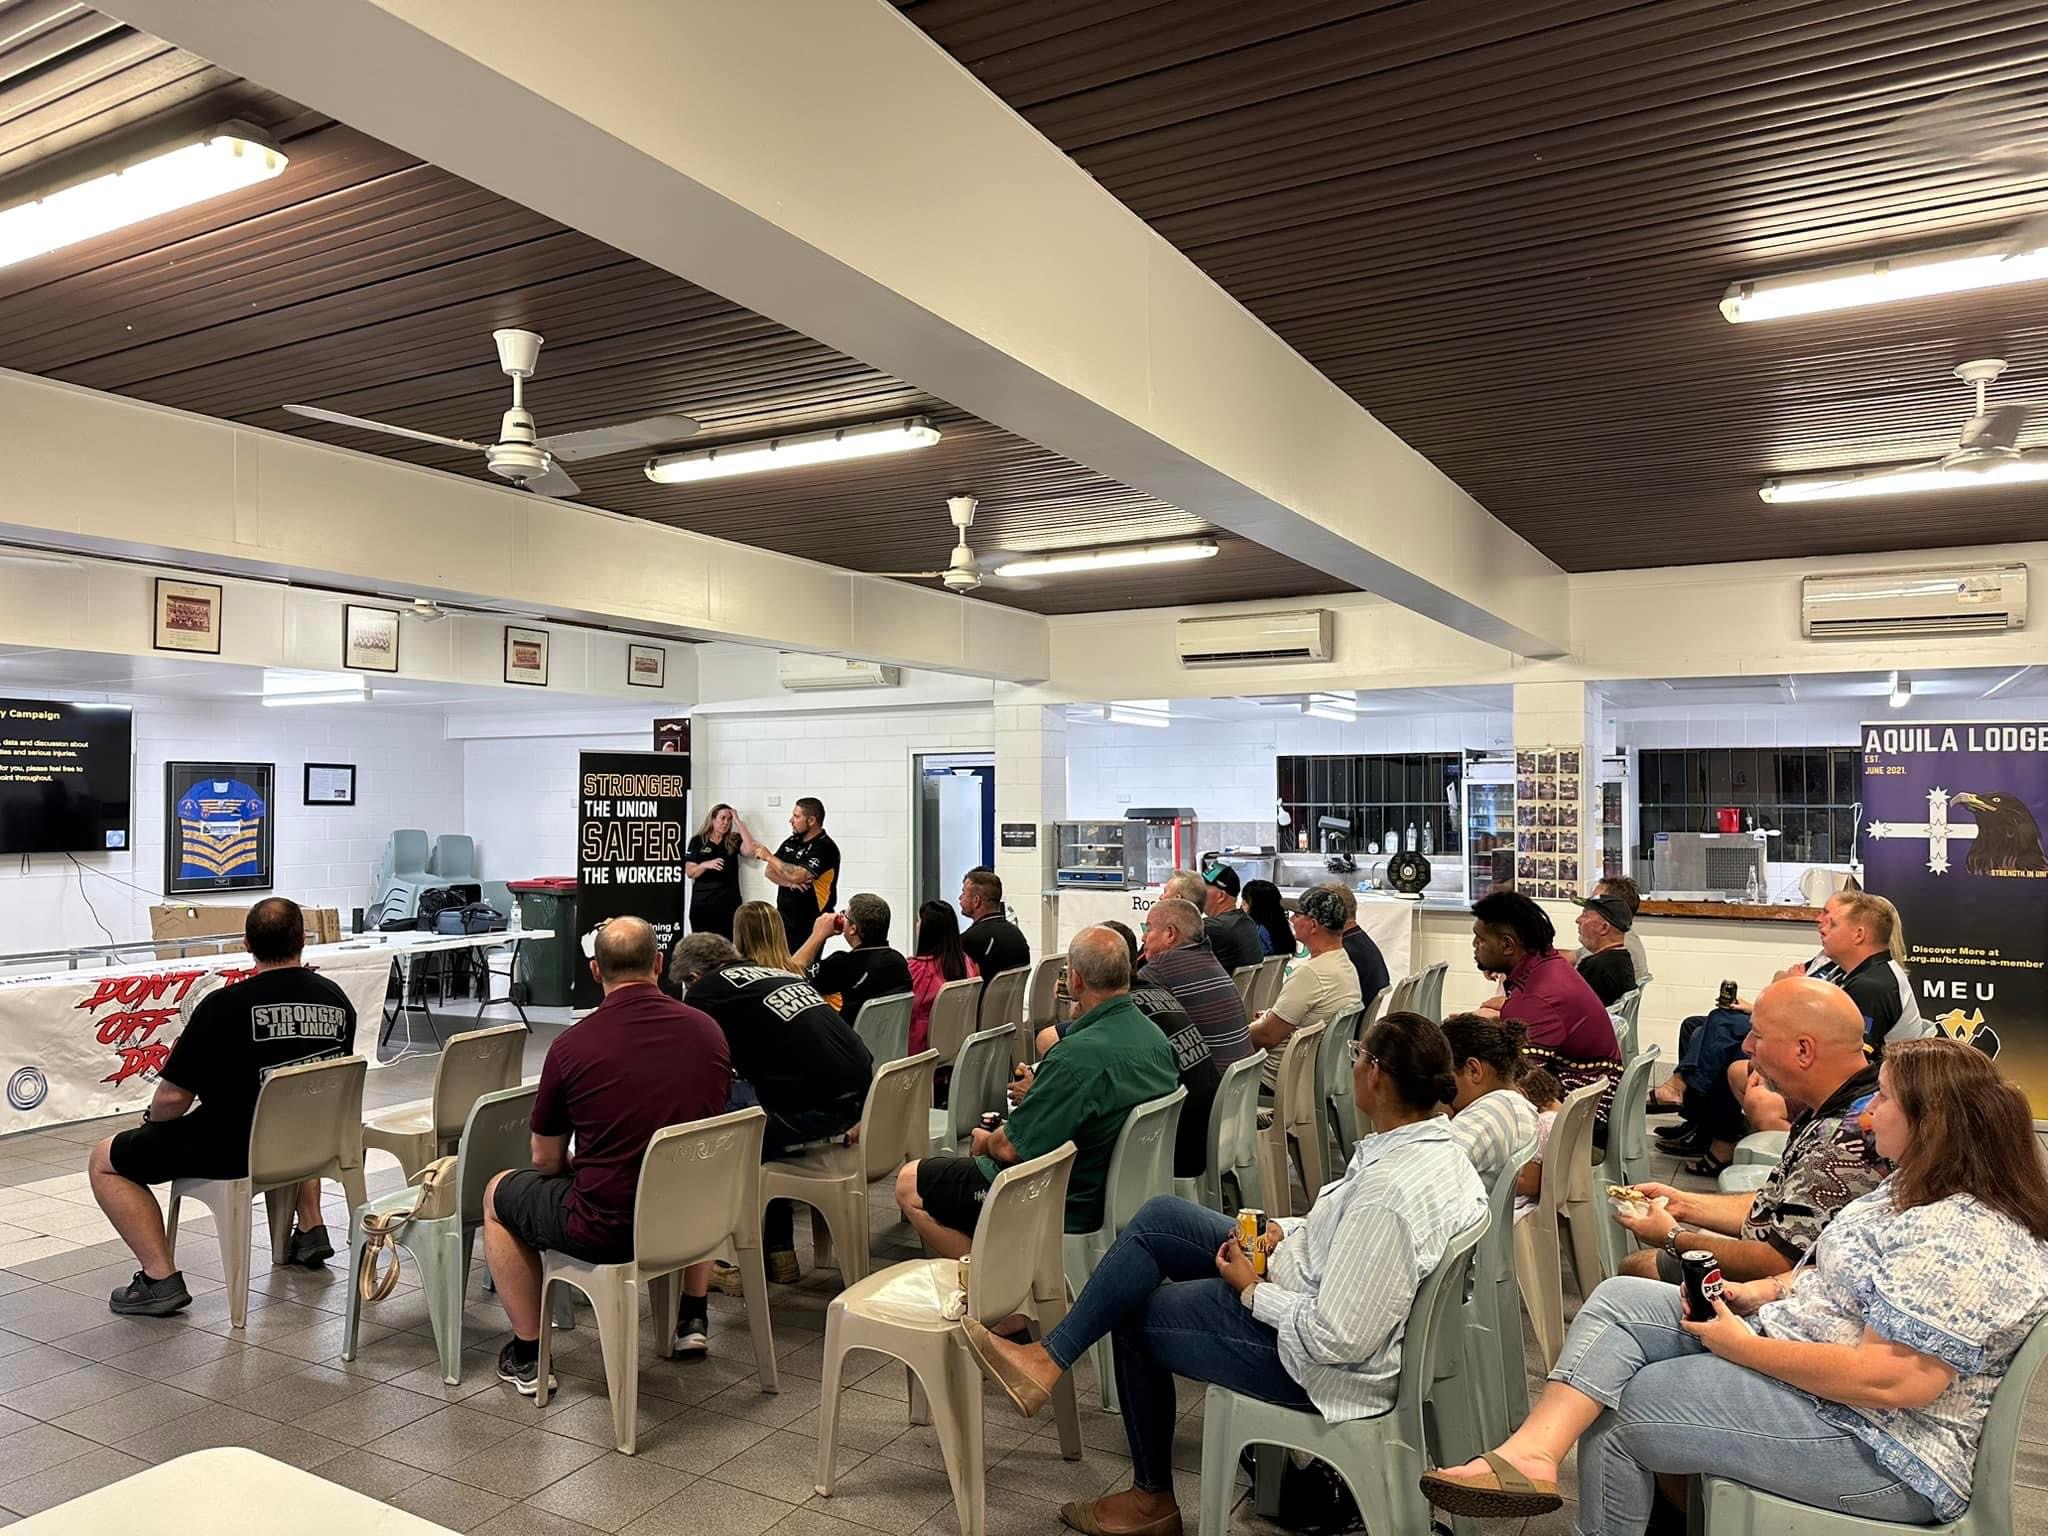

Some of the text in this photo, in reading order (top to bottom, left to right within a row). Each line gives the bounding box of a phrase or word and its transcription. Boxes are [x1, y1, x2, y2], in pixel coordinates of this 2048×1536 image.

[9, 709, 61, 721] Campaign
[20, 739, 33, 747] and
[34, 739, 69, 748] discussion
[70, 741, 89, 749] about
[1864, 727, 2048, 755] AQUILA LODGE
[1864, 755, 1881, 763] EST.
[26, 765, 48, 773] please
[1864, 767, 1884, 775] JUNE
[583, 773, 683, 797] STRONGER
[584, 800, 658, 818] THE UNION
[582, 821, 681, 862] SAFER
[582, 866, 682, 884] THE WORKERS
[673, 922, 681, 931] &
[1912, 945, 2000, 957] Discover More at
[75, 970, 208, 1014] DON'T
[255, 1006, 343, 1026] STRONGER
[95, 1007, 182, 1046] OFF
[267, 1022, 297, 1037] THE
